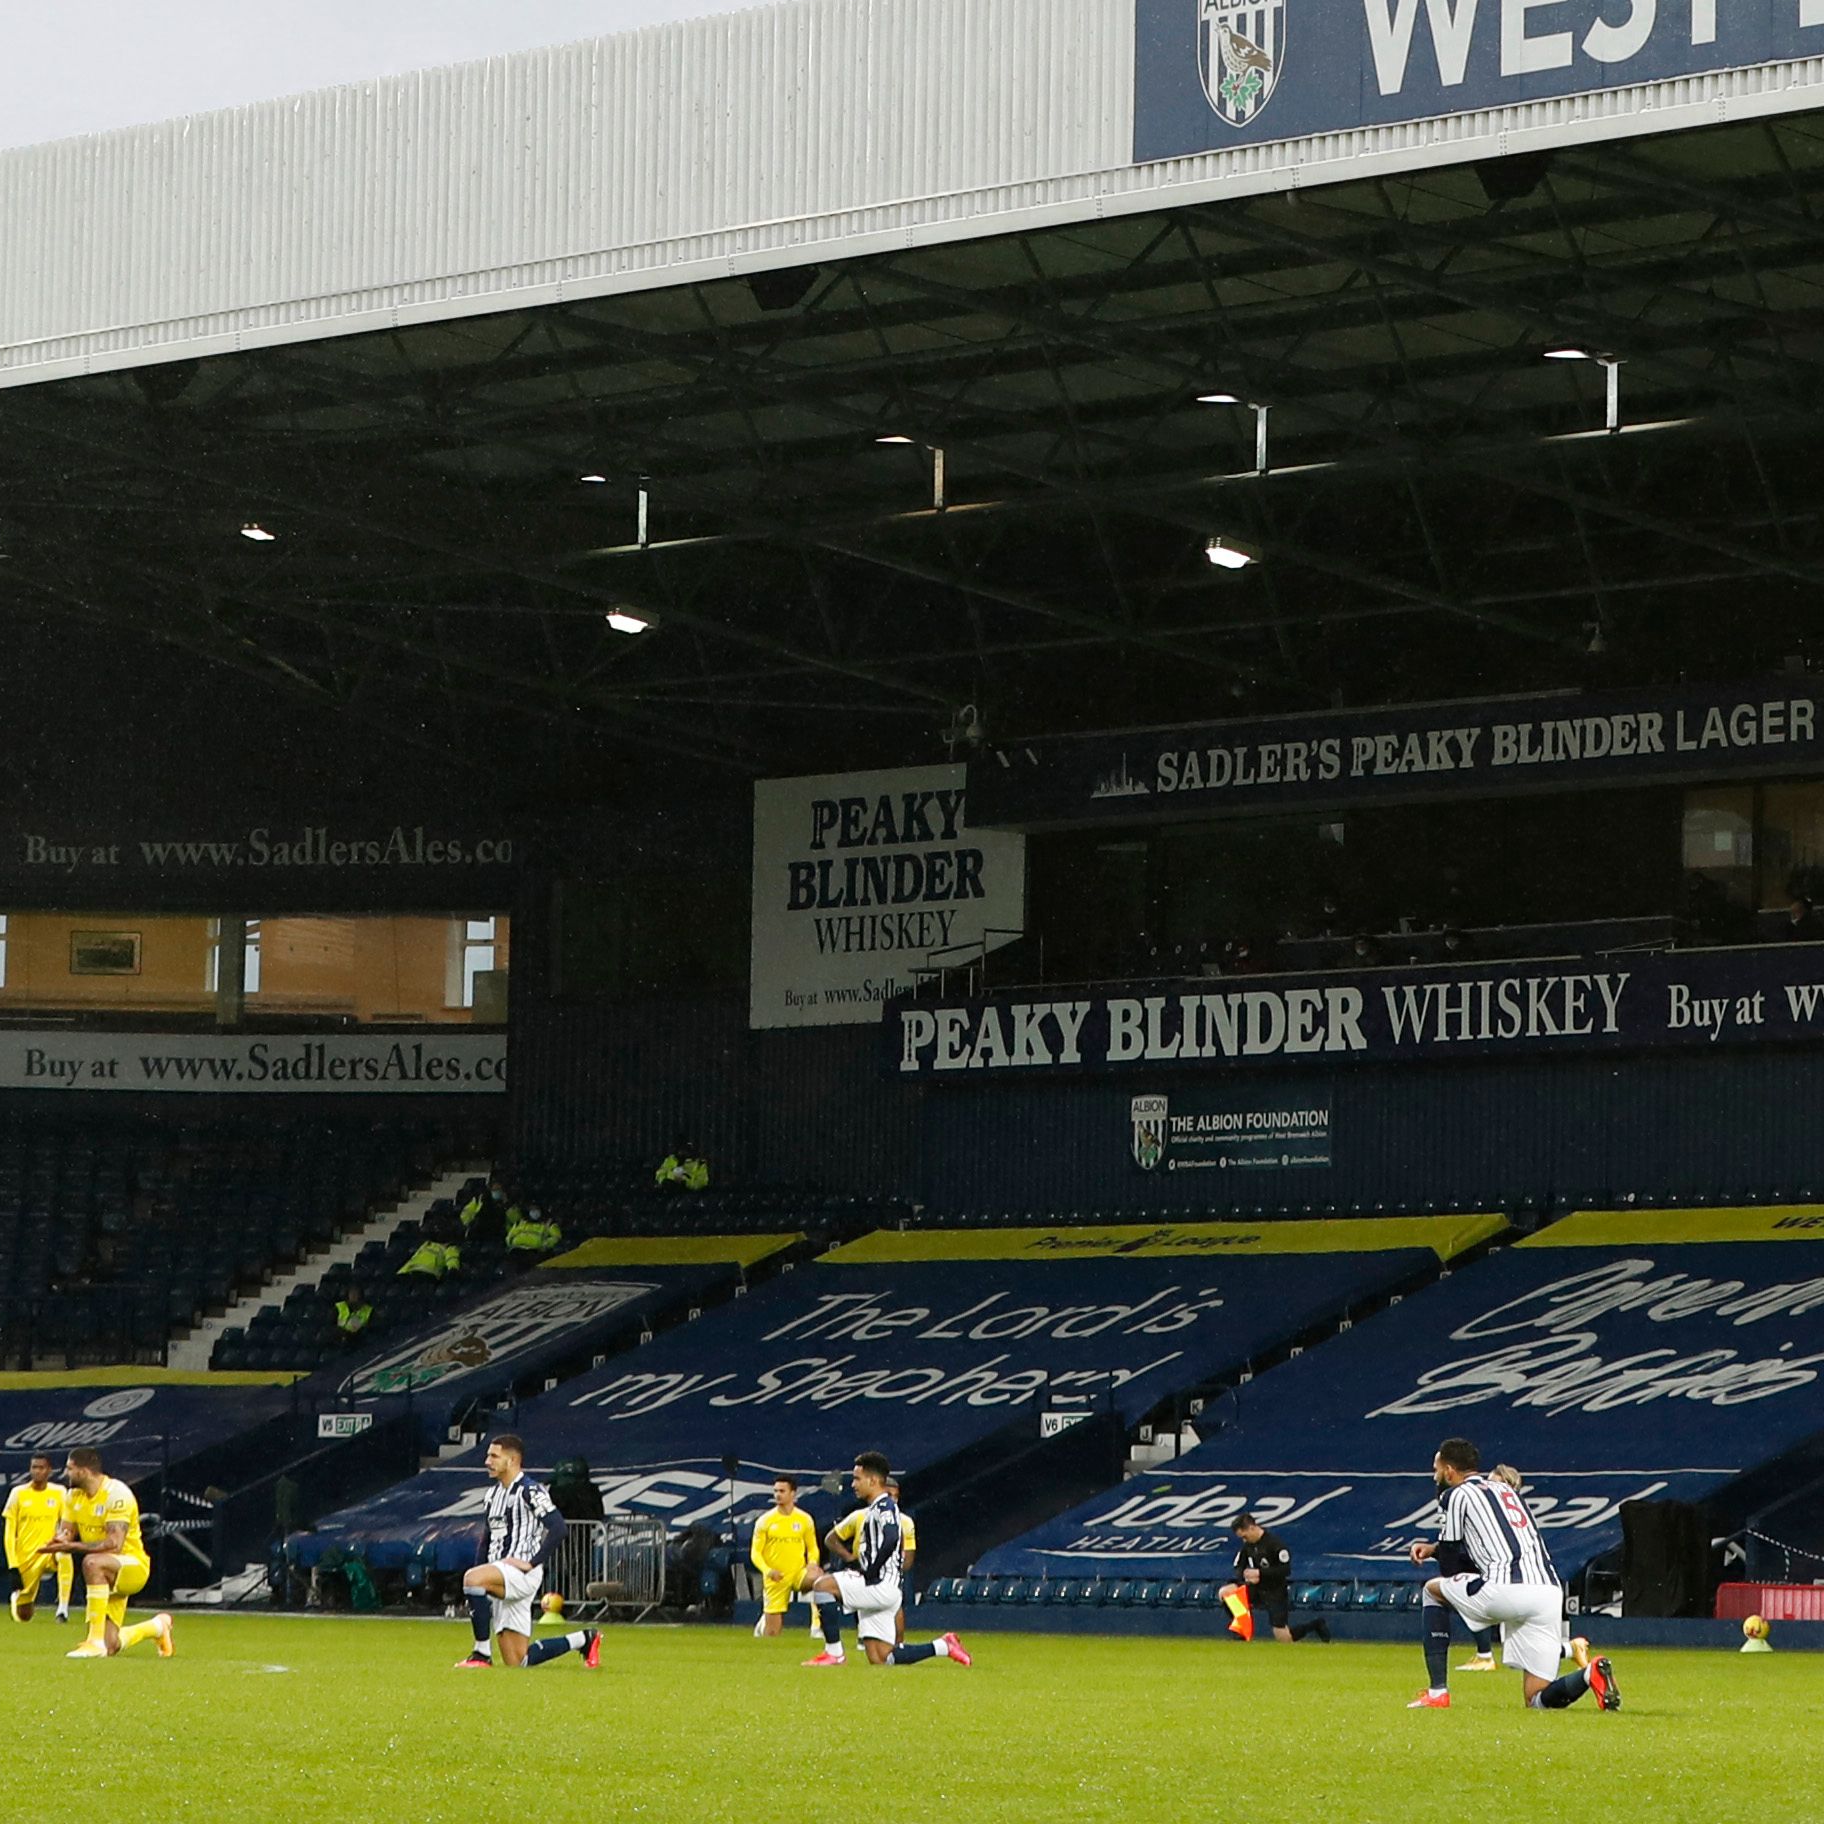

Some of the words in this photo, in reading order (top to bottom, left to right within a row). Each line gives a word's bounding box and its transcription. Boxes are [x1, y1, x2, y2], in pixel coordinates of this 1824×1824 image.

[1156, 738, 1341, 793] SADLER'S
[1351, 728, 1481, 776] PEAKY
[1491, 711, 1665, 766] BLINDER
[1676, 699, 1815, 751] LAGER
[810, 789, 966, 850] PEAKY
[26, 835, 84, 872] Buy
[88, 843, 118, 866] at
[787, 848, 985, 910] BLINDER
[813, 909, 957, 954] WHISKEY
[785, 990, 806, 1011] Buy
[807, 993, 818, 1005] at
[900, 1001, 1090, 1071] PEAKY
[1106, 986, 1367, 1062] BLINDER
[1381, 972, 1631, 1045] WHISKEY
[1667, 984, 1727, 1041] Buy
[1735, 988, 1765, 1026] at
[25, 1049, 83, 1085] Buy
[87, 1057, 118, 1079] at
[1133, 1100, 1165, 1113] ALBION
[1170, 1116, 1194, 1132] THE
[1197, 1113, 1242, 1131] ALBION
[1246, 1110, 1328, 1129] FOUNDATION
[473, 1298, 619, 1321] ALBION
[761, 1290, 930, 1341] The
[916, 1286, 1181, 1340] Lord
[1123, 1287, 1224, 1334] is
[569, 1373, 737, 1419] my
[1045, 1418, 1058, 1431] V6
[1083, 1484, 1352, 1528] ideal
[1501, 1491, 1527, 1528] 5
[1067, 1536, 1228, 1551] HEATING
